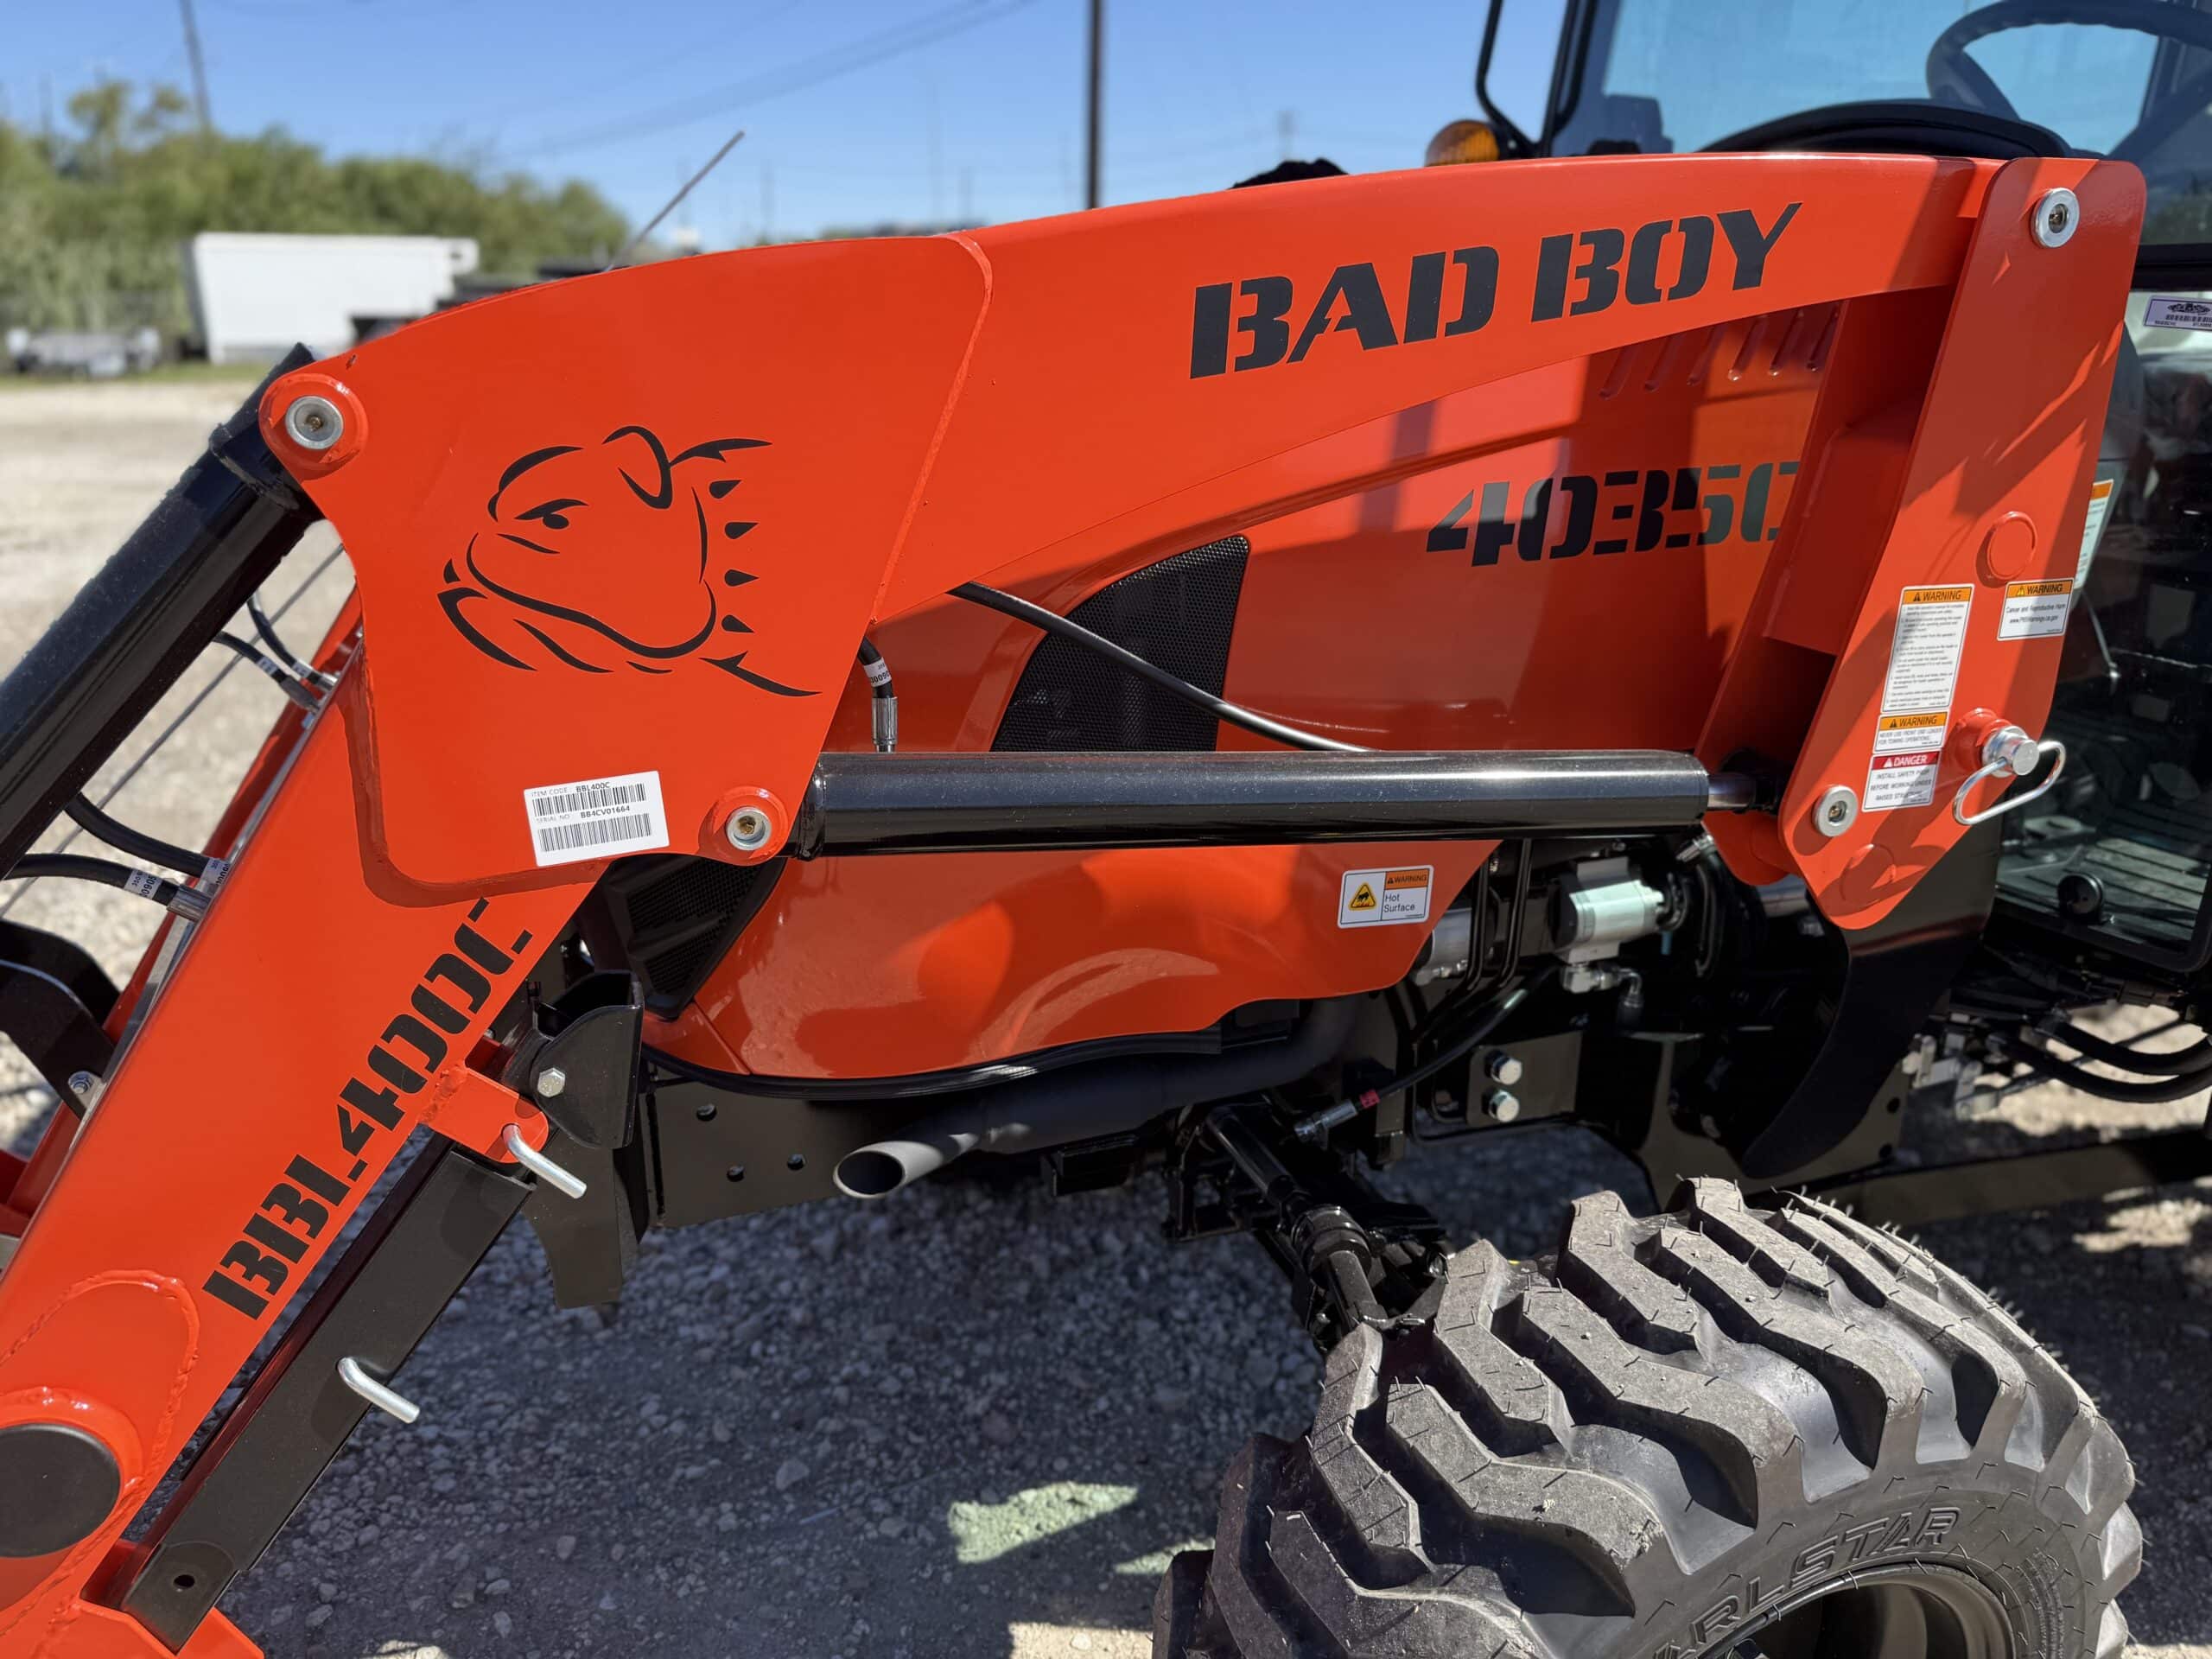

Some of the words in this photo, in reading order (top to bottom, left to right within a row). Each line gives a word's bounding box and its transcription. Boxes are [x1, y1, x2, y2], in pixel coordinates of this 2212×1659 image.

[1189, 245, 1499, 379] BAD
[1531, 201, 1803, 322] BOY
[2027, 584, 2063, 595] WARNING
[1923, 590, 1962, 601] WARNING
[1899, 715, 1937, 728] WARNING
[1893, 754, 1928, 767] DANGER
[575, 781, 610, 793] BBL400C
[1394, 874, 1427, 884] WARNING
[1384, 893, 1400, 903] Hot
[1383, 903, 1415, 913] Surface
[201, 896, 533, 1321] BBL400C
